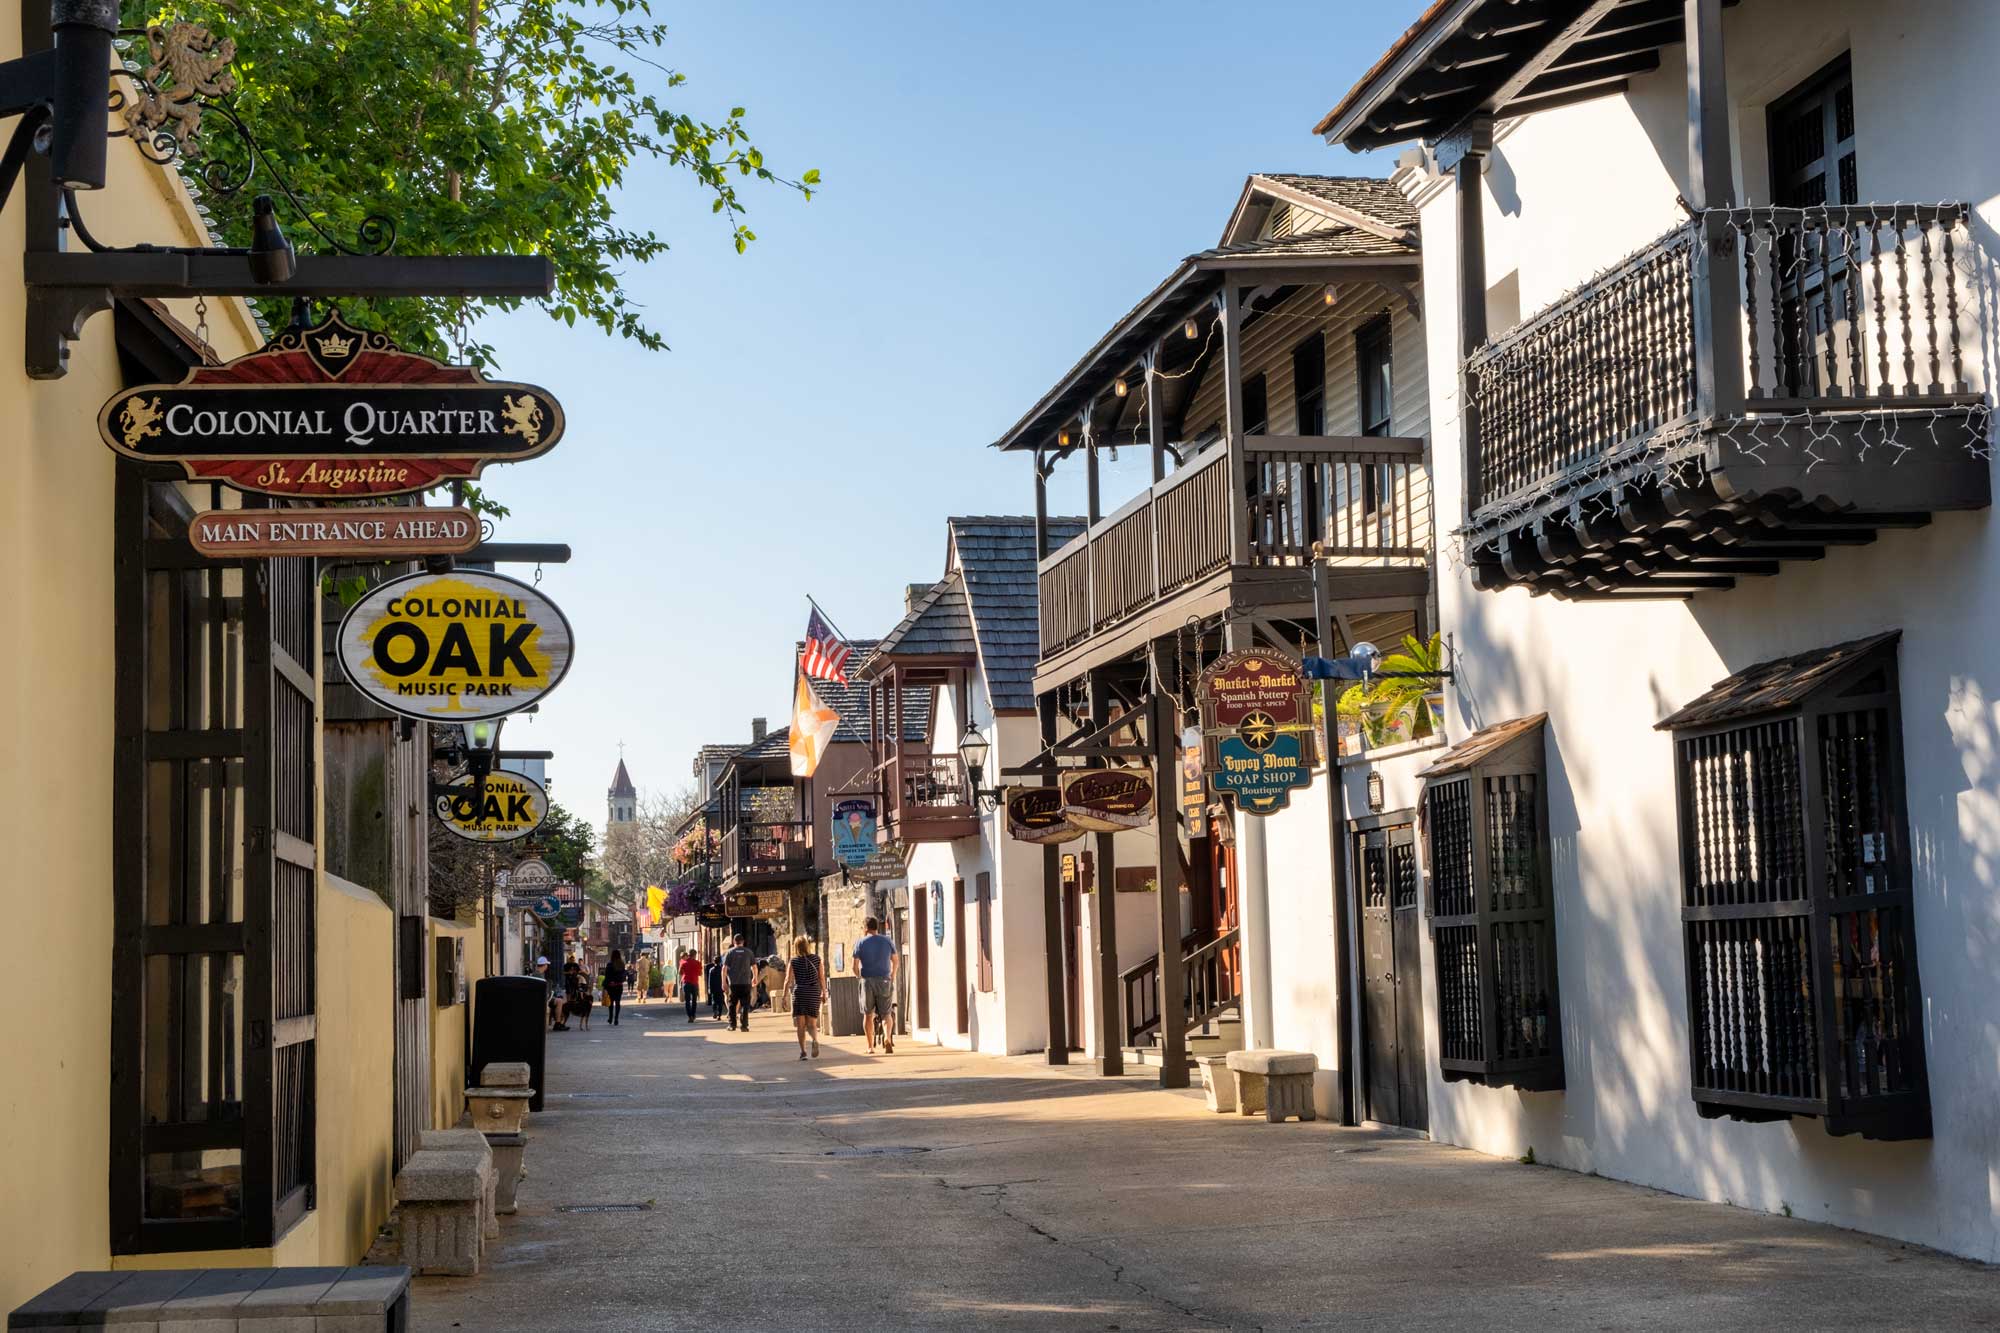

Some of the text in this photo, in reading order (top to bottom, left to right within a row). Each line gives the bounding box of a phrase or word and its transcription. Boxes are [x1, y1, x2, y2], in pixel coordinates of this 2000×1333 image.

[165, 402, 498, 445] COLONIAL QUARTER
[258, 461, 408, 488] St. Augustine
[201, 519, 468, 543] MAIN ENTRANCE AHEAD
[386, 598, 527, 618] COLONIAL
[373, 621, 538, 677] OAK
[1205, 652, 1237, 675] ARTISAN
[398, 682, 512, 696] MUSIC PARK
[1214, 676, 1250, 691] Market
[1259, 673, 1296, 689] Market
[1221, 690, 1290, 704] Spanish Pottery
[1223, 753, 1297, 772] Gypsy Moon
[1226, 772, 1296, 785] SOAP SHOP
[1241, 786, 1283, 795] Boutique
[463, 824, 520, 832] MUSIC PARK
